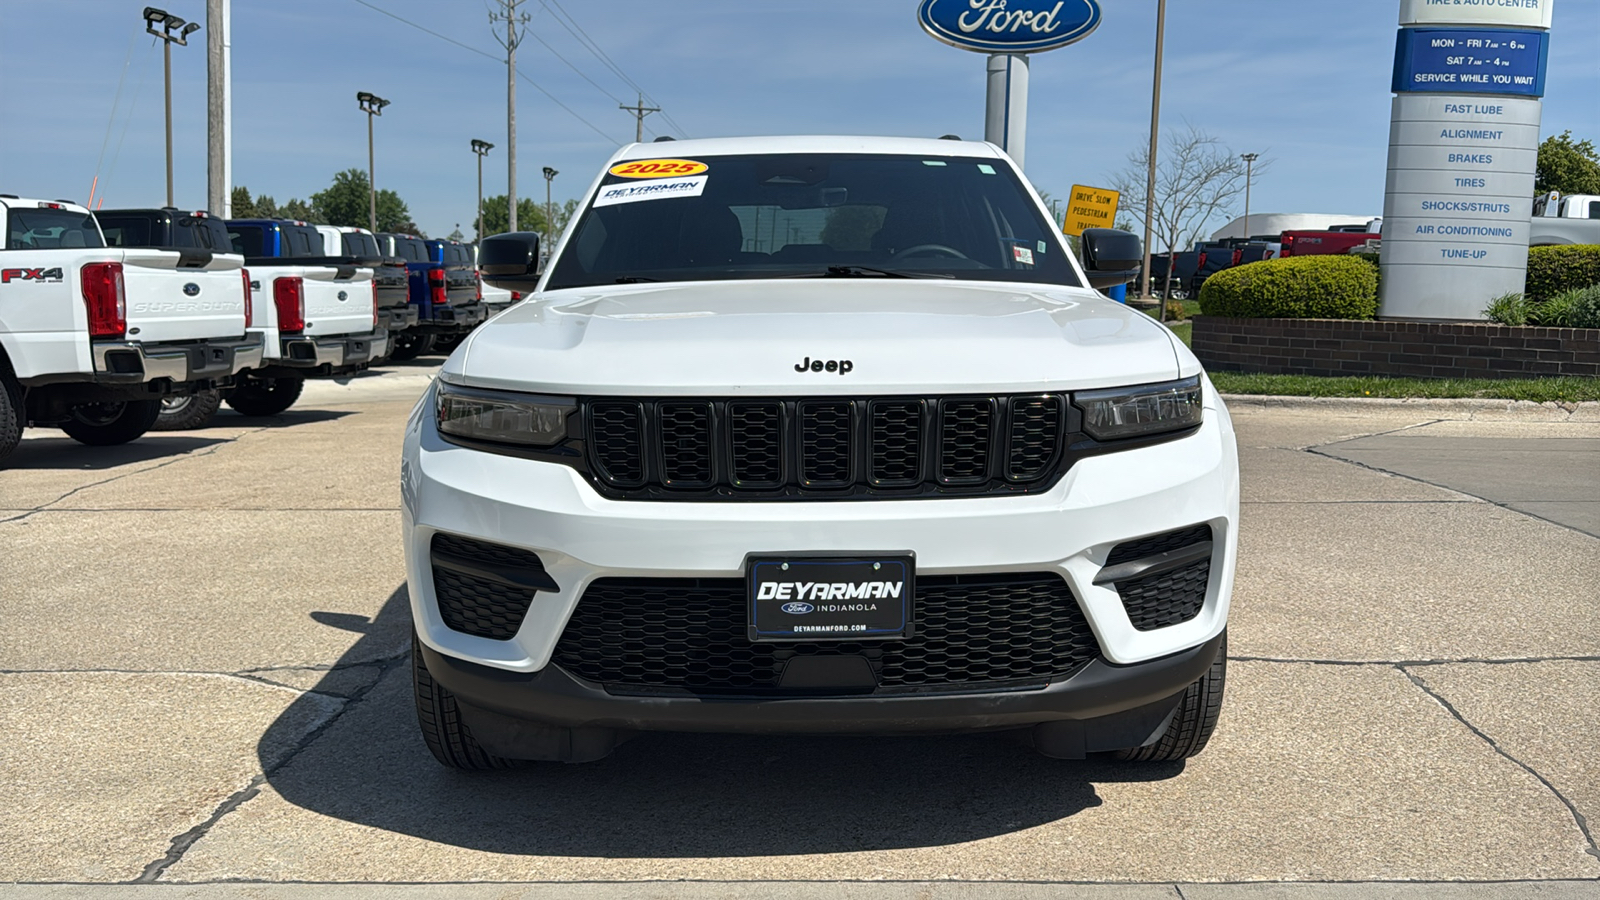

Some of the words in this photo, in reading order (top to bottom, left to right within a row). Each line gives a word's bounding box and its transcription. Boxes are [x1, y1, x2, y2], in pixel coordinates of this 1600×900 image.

[1498, 0, 1538, 9] CENTER
[958, 0, 1064, 33] Ford
[1431, 39, 1455, 48] MON
[1467, 39, 1482, 48] FRI
[1446, 56, 1465, 66] SAT
[1414, 73, 1457, 83] SERVICE
[1460, 74, 1489, 84] WHILE
[1492, 74, 1511, 85] YOU
[1514, 76, 1534, 86] WAIT
[1444, 104, 1472, 114] FAST
[1475, 105, 1503, 115] LUBE
[1440, 129, 1503, 140] ALIGNMENT
[1448, 153, 1493, 164] BRAKES
[618, 164, 699, 173] 2025
[1454, 178, 1486, 188] TIRES
[604, 181, 699, 197] DEYARMAN
[1076, 193, 1093, 202] DRIVE
[1096, 196, 1111, 205] SLOW
[1073, 207, 1108, 218] PEDESTRIAN
[1421, 201, 1510, 213] SHOCKS/STRUTS
[1415, 225, 1434, 234] AIR
[1437, 226, 1513, 237] CONDITIONING
[1441, 249, 1487, 259] TUNE-UP
[1, 267, 63, 283] FX4
[134, 302, 199, 313] SUPER
[201, 301, 241, 311] DUTY
[794, 356, 854, 376] Jeep
[757, 581, 903, 600] DEYARMAN
[787, 603, 808, 612] Ford
[816, 603, 877, 612] INDIANOLA
[793, 624, 867, 632] DEYARMANFORD.COM
